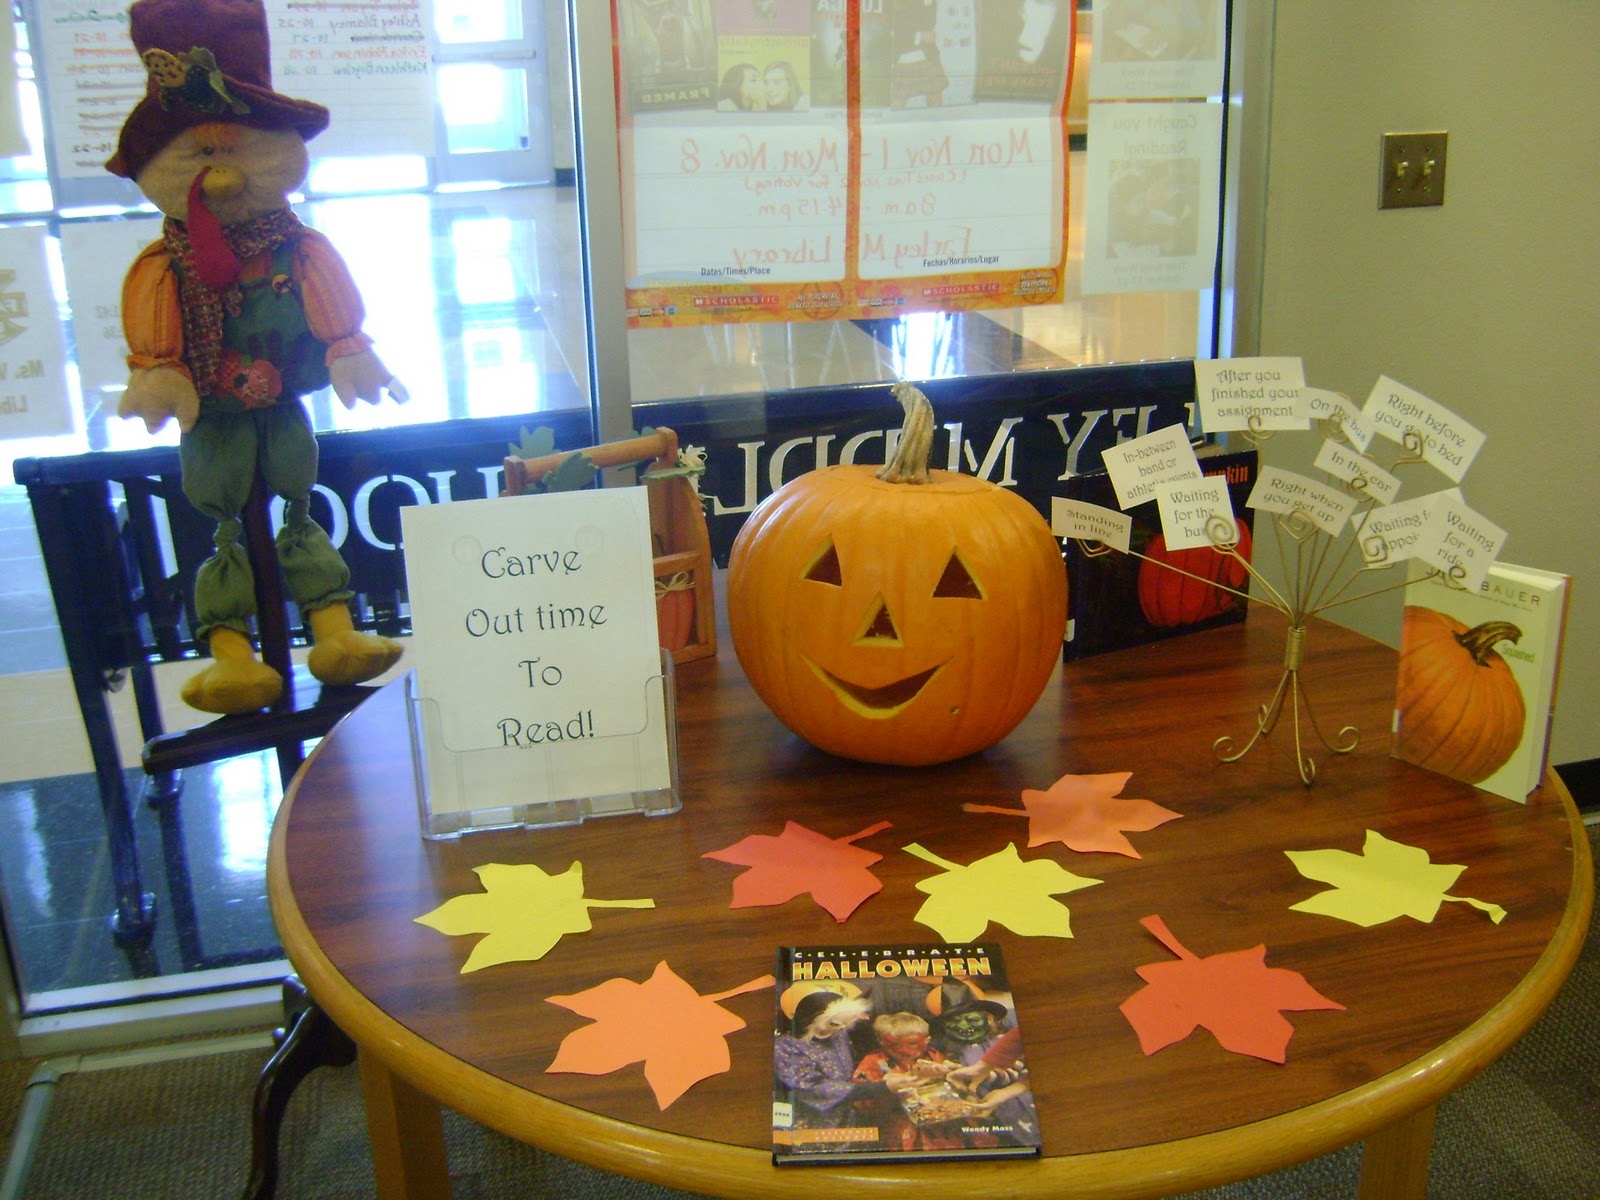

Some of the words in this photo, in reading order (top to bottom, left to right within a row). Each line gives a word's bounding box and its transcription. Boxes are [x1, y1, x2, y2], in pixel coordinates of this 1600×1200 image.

[705, 296, 778, 306] SCHOLASTIC
[933, 283, 999, 296] SCHOLASTIC
[1216, 369, 1251, 384] After
[1255, 371, 1281, 384] you
[1211, 387, 1265, 402] finished
[1269, 389, 1299, 401] your
[1310, 398, 1330, 411] On
[1217, 405, 1293, 418] assignment
[1388, 393, 1422, 420] Right
[1425, 412, 1466, 448] before
[1375, 410, 1401, 429] you
[1423, 434, 1437, 449] to
[1438, 443, 1463, 466] bed
[1123, 439, 1177, 464] In-between
[1138, 460, 1165, 477] band
[1166, 457, 1177, 471] or
[1331, 451, 1345, 465] In
[1348, 460, 1368, 478] the
[1170, 488, 1220, 505] Waiting
[1271, 478, 1307, 496] Right
[1310, 489, 1344, 512] when
[1066, 508, 1124, 533] Standing
[1174, 509, 1193, 524] for
[1195, 507, 1215, 520] the
[1264, 493, 1290, 505] you
[1291, 499, 1314, 513] get
[1317, 510, 1335, 523] up
[1074, 522, 1086, 531] in
[1090, 524, 1113, 539] line
[1369, 514, 1422, 534] Waiting
[1447, 511, 1496, 552] Waiting
[1443, 531, 1465, 548] for
[1466, 549, 1474, 558] a
[481, 546, 582, 579] Carve
[1437, 548, 1464, 567] ride
[1481, 581, 1541, 606] BAUER
[465, 608, 524, 637] Out
[536, 603, 608, 630] time
[518, 657, 562, 688] To
[497, 709, 595, 748] Read!
[792, 956, 992, 982] HALLOWEEN
[961, 1125, 990, 1135] Wendy
